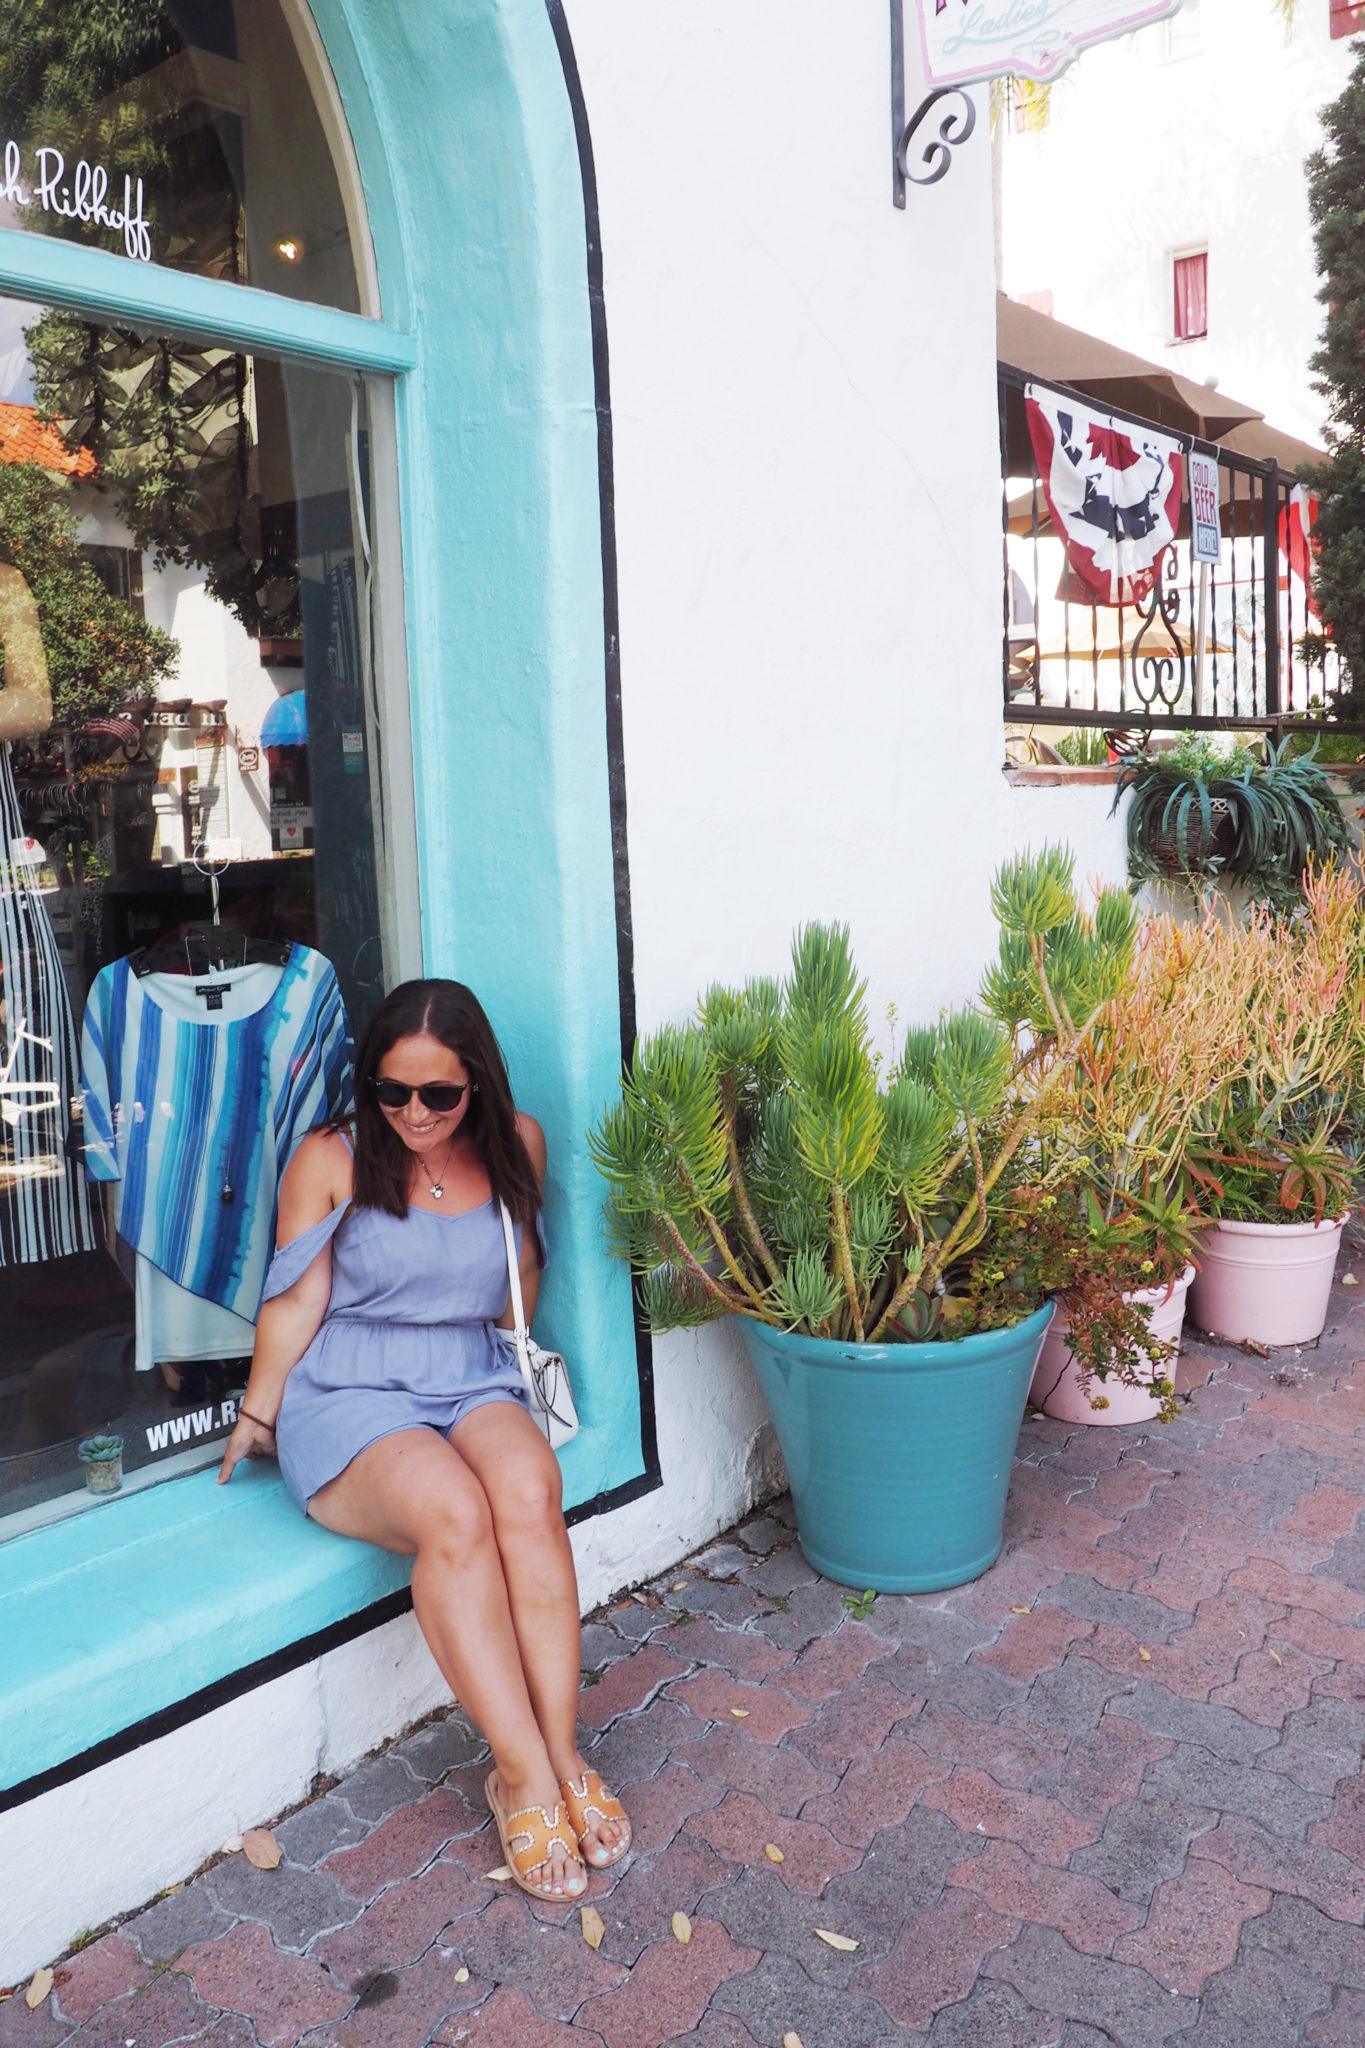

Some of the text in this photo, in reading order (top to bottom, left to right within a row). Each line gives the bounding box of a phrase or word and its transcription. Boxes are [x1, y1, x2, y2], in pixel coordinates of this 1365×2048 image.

[34, 147, 151, 262] Ribkoff
[1192, 461, 1209, 487] COLD
[1193, 486, 1217, 525] BEER
